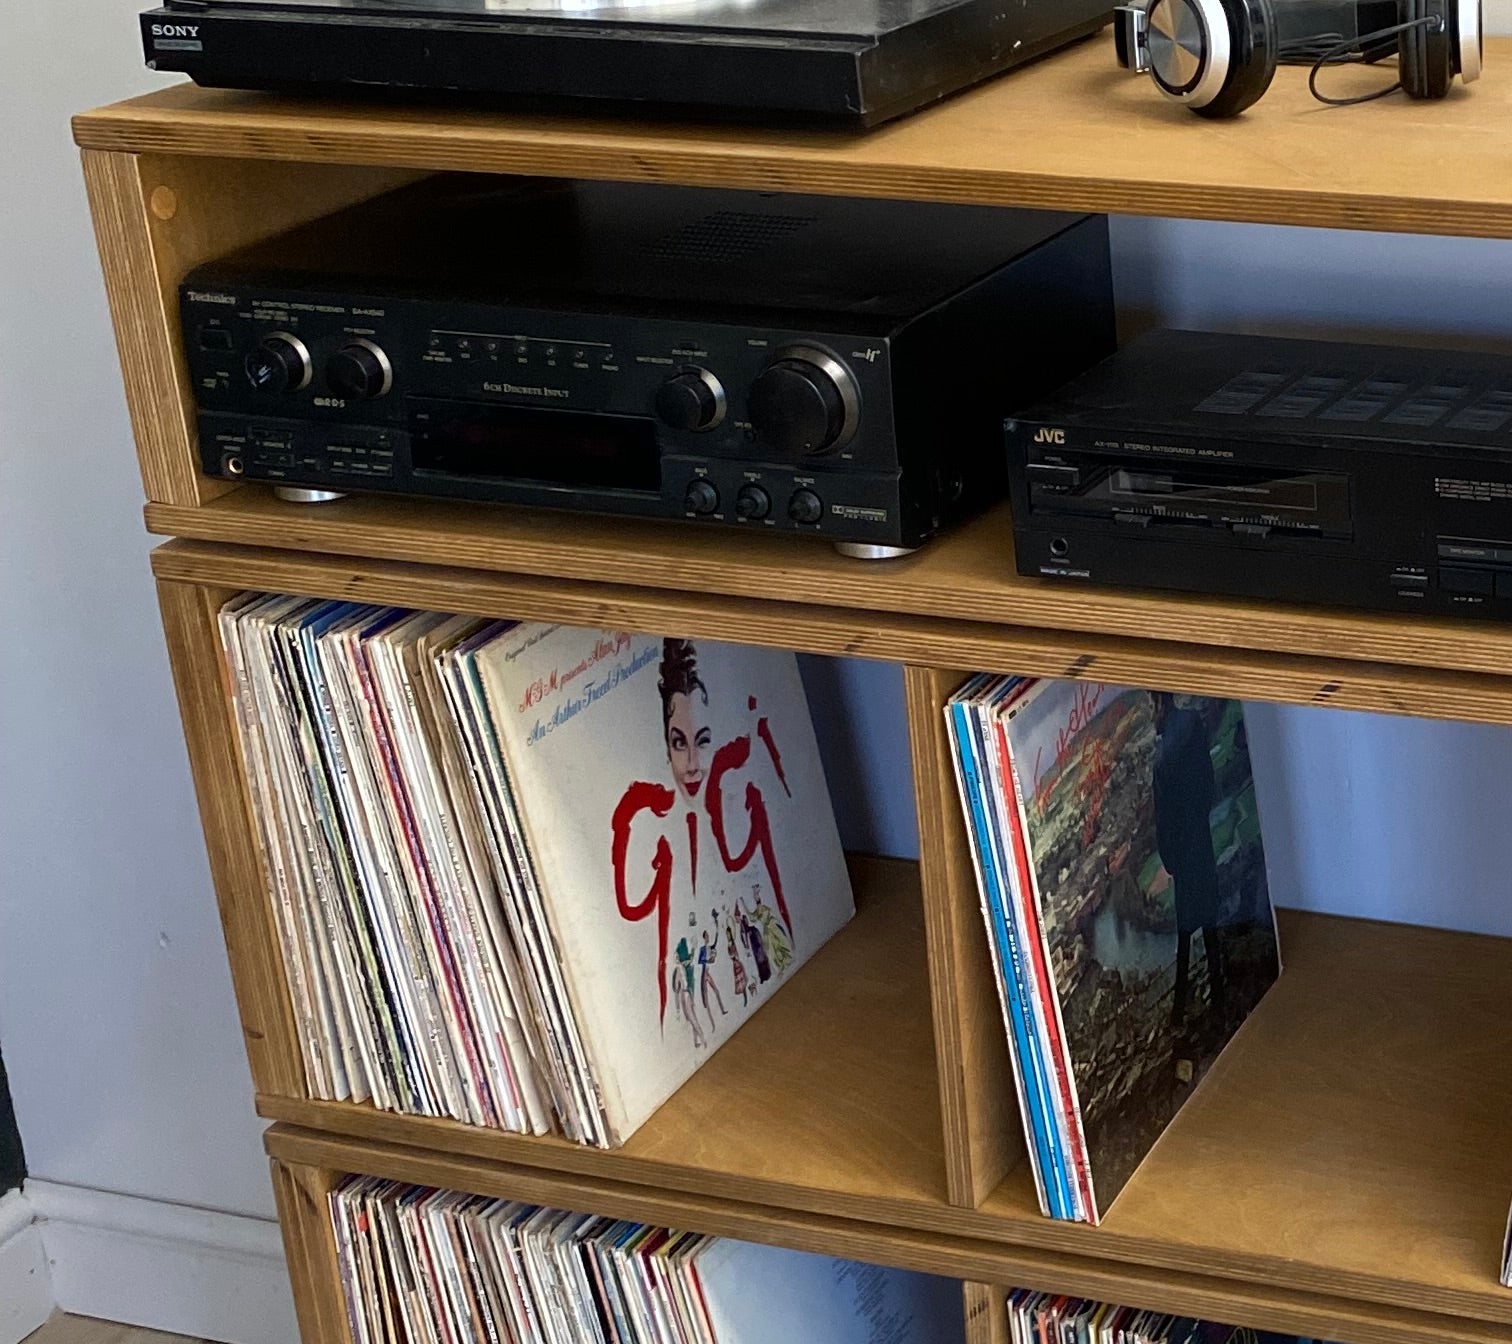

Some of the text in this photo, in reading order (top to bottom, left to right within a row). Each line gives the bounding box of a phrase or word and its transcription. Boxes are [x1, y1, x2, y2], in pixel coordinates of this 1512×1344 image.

[151, 25, 199, 36] SONY
[187, 292, 236, 305] Technics
[1034, 427, 1066, 445] JVC
